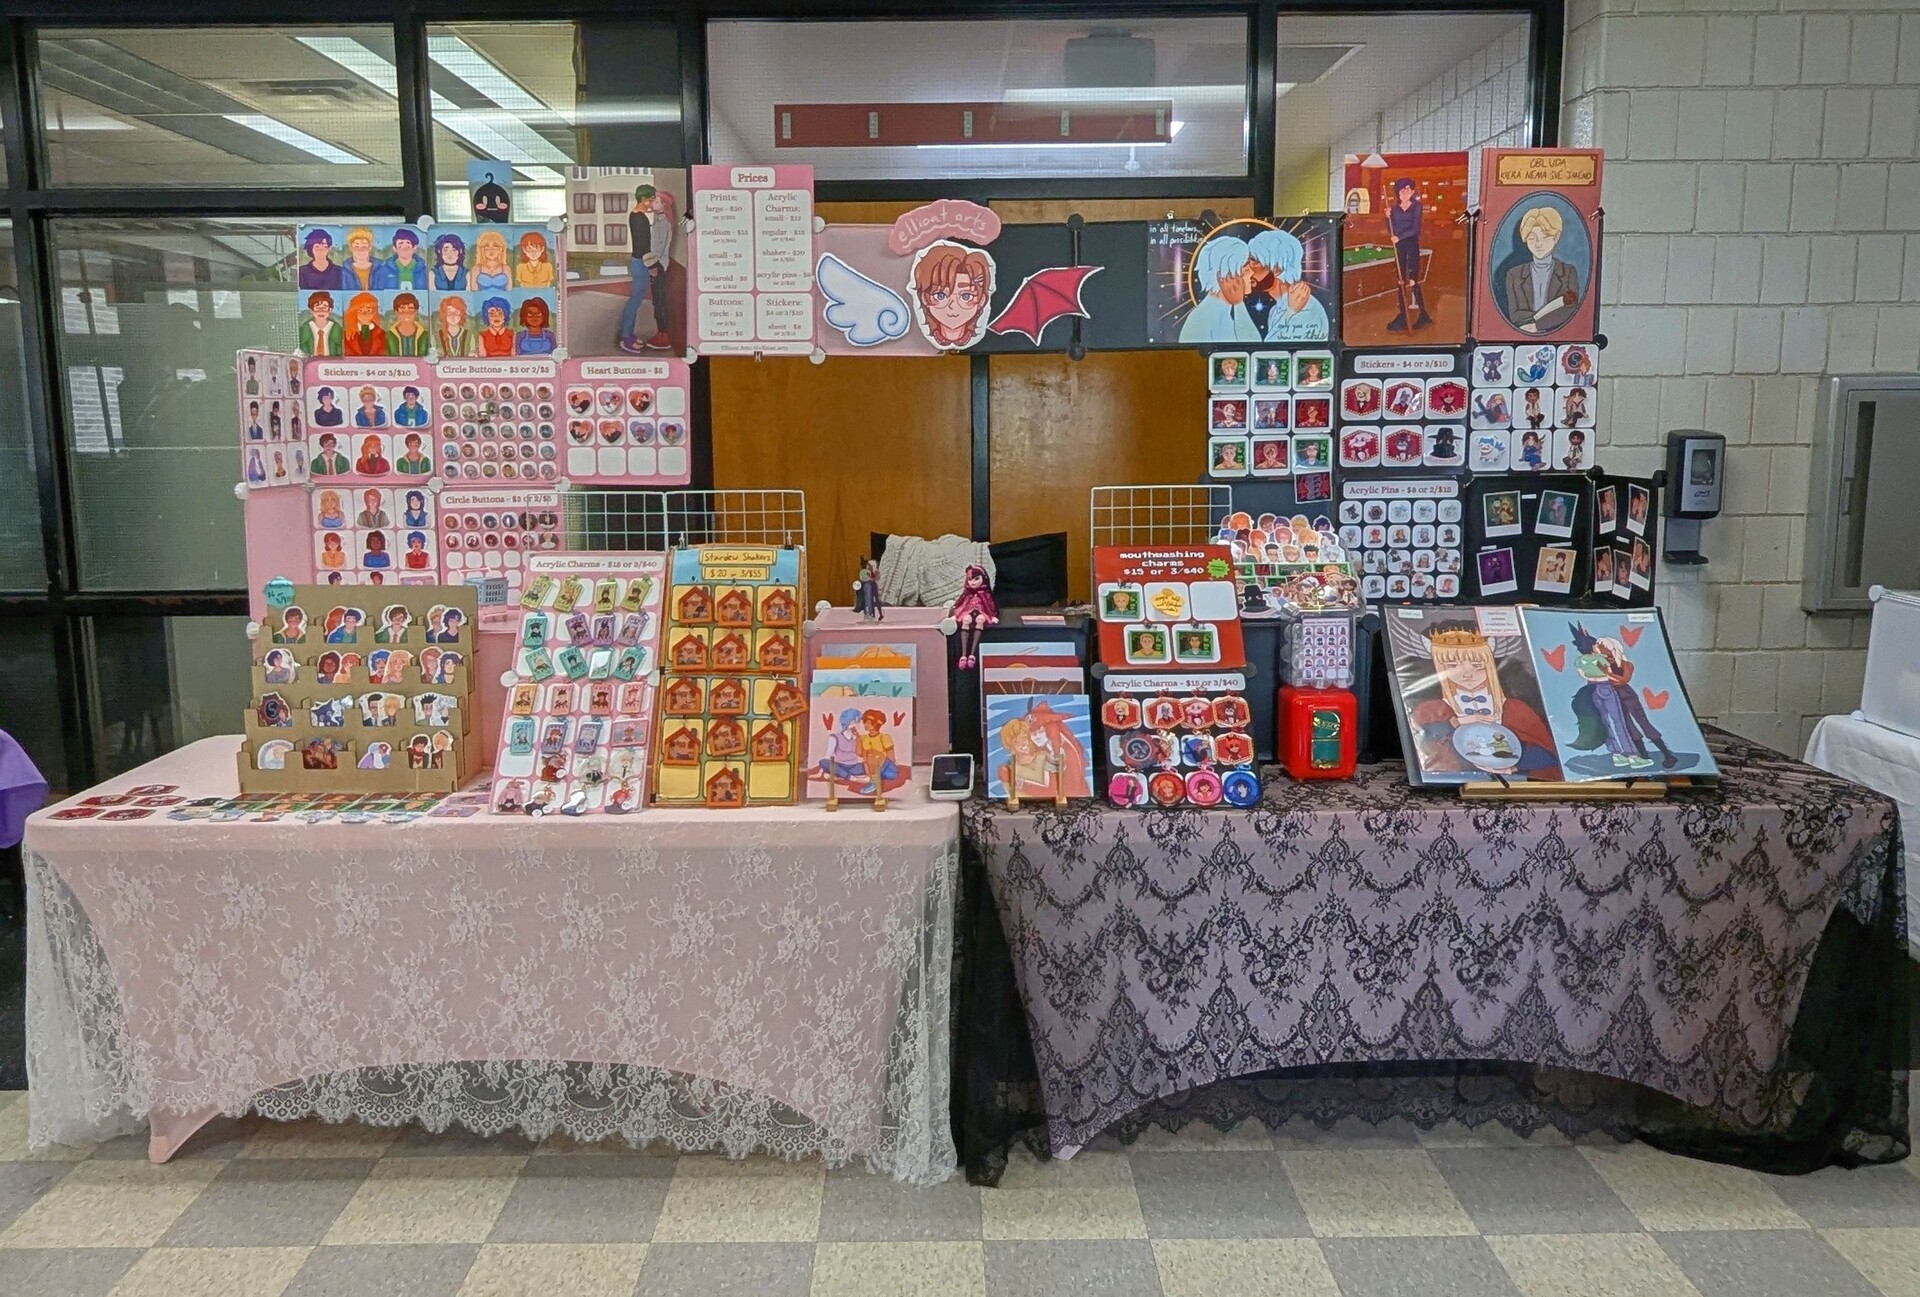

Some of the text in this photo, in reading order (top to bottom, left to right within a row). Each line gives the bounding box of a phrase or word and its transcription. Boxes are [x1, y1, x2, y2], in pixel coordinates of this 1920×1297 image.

[737, 173, 769, 183] Prices
[767, 192, 798, 203] Acrylic
[765, 204, 800, 213] Charms:
[1360, 360, 1394, 369] Stickers
[1402, 360, 1412, 368] $4
[1425, 360, 1448, 369] 3/$10
[324, 368, 358, 377] Stickers
[366, 369, 376, 377] $4
[388, 368, 411, 378] 3/$10
[442, 365, 467, 374] Circle
[469, 365, 502, 374] Buttons
[509, 366, 519, 374] $3
[531, 365, 549, 375] 2/$5
[587, 367, 611, 375] Heart
[613, 366, 647, 375] Buttons
[654, 367, 663, 375] $5
[1349, 486, 1379, 496] Acrylic
[1381, 486, 1399, 494] Pins
[1407, 486, 1416, 494] $8
[1429, 485, 1452, 495] 2/$15
[445, 496, 470, 504] Circle
[472, 495, 505, 503] Buttons
[704, 552, 771, 562] Stardew Shakers
[1119, 550, 1205, 559] mouthwashing
[536, 560, 566, 570] Acrylic
[567, 560, 600, 569] Charms
[607, 560, 620, 568] $15
[633, 560, 657, 569] 3/$40
[1170, 567, 1205, 575] 3/$40
[1110, 679, 1142, 689] Acrylic
[1143, 679, 1178, 688] Charms
[1213, 678, 1238, 688] 3/$40
